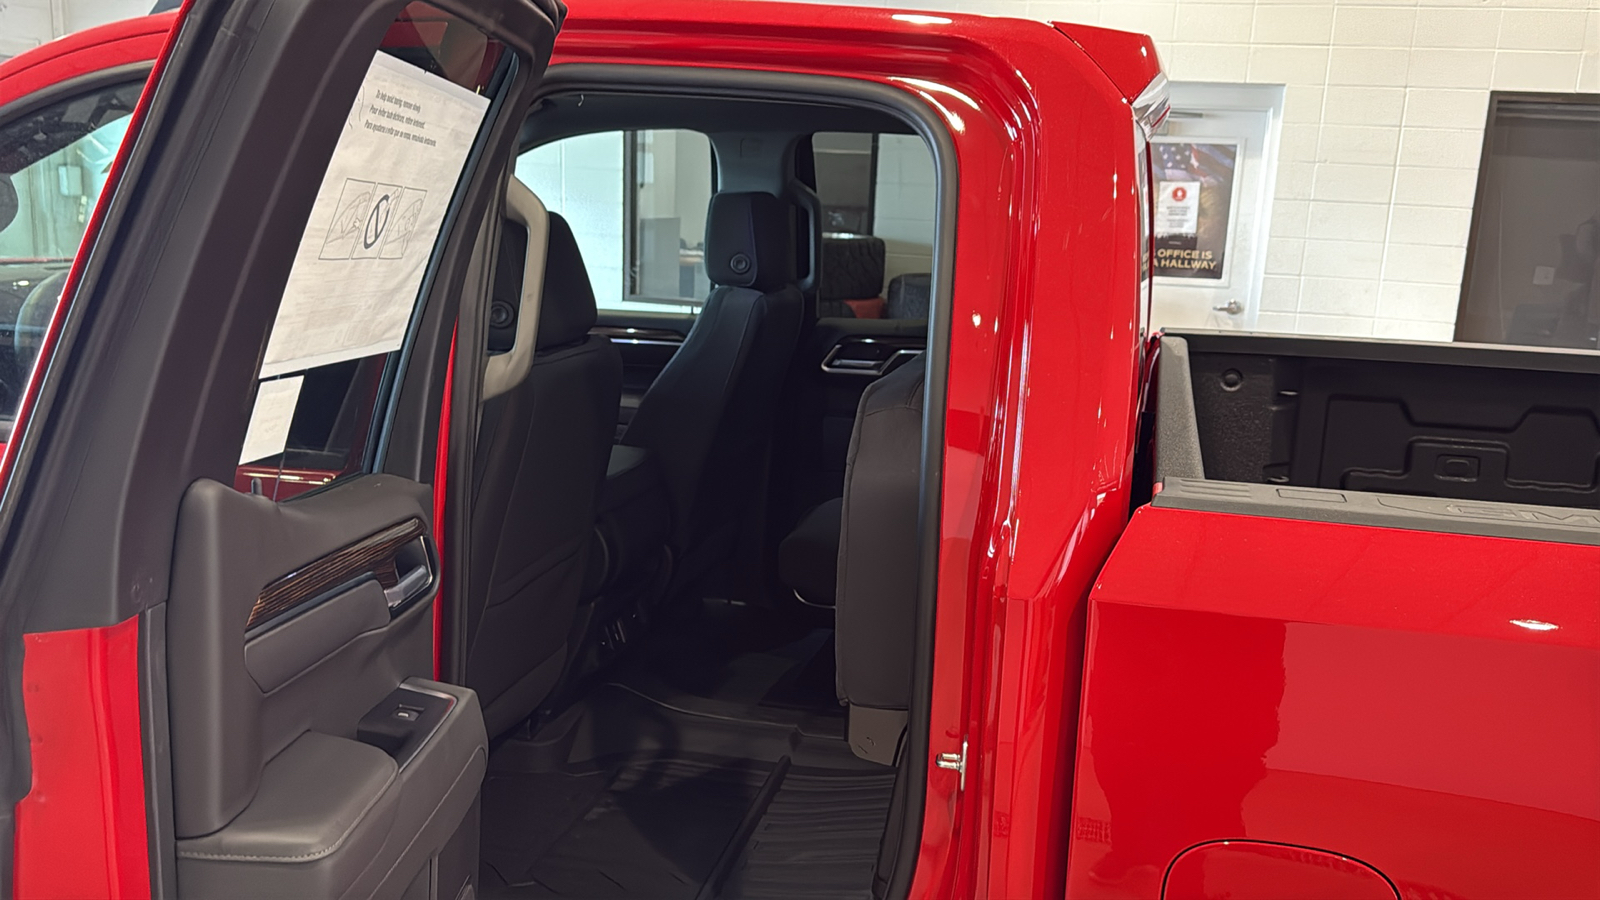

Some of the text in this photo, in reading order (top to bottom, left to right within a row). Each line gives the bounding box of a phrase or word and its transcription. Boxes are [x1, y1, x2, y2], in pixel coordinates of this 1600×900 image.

[1157, 248, 1200, 259] OFFICE
[1201, 250, 1213, 260] IS
[1160, 259, 1217, 270] HALLWAY
[1446, 504, 1600, 525] GM
